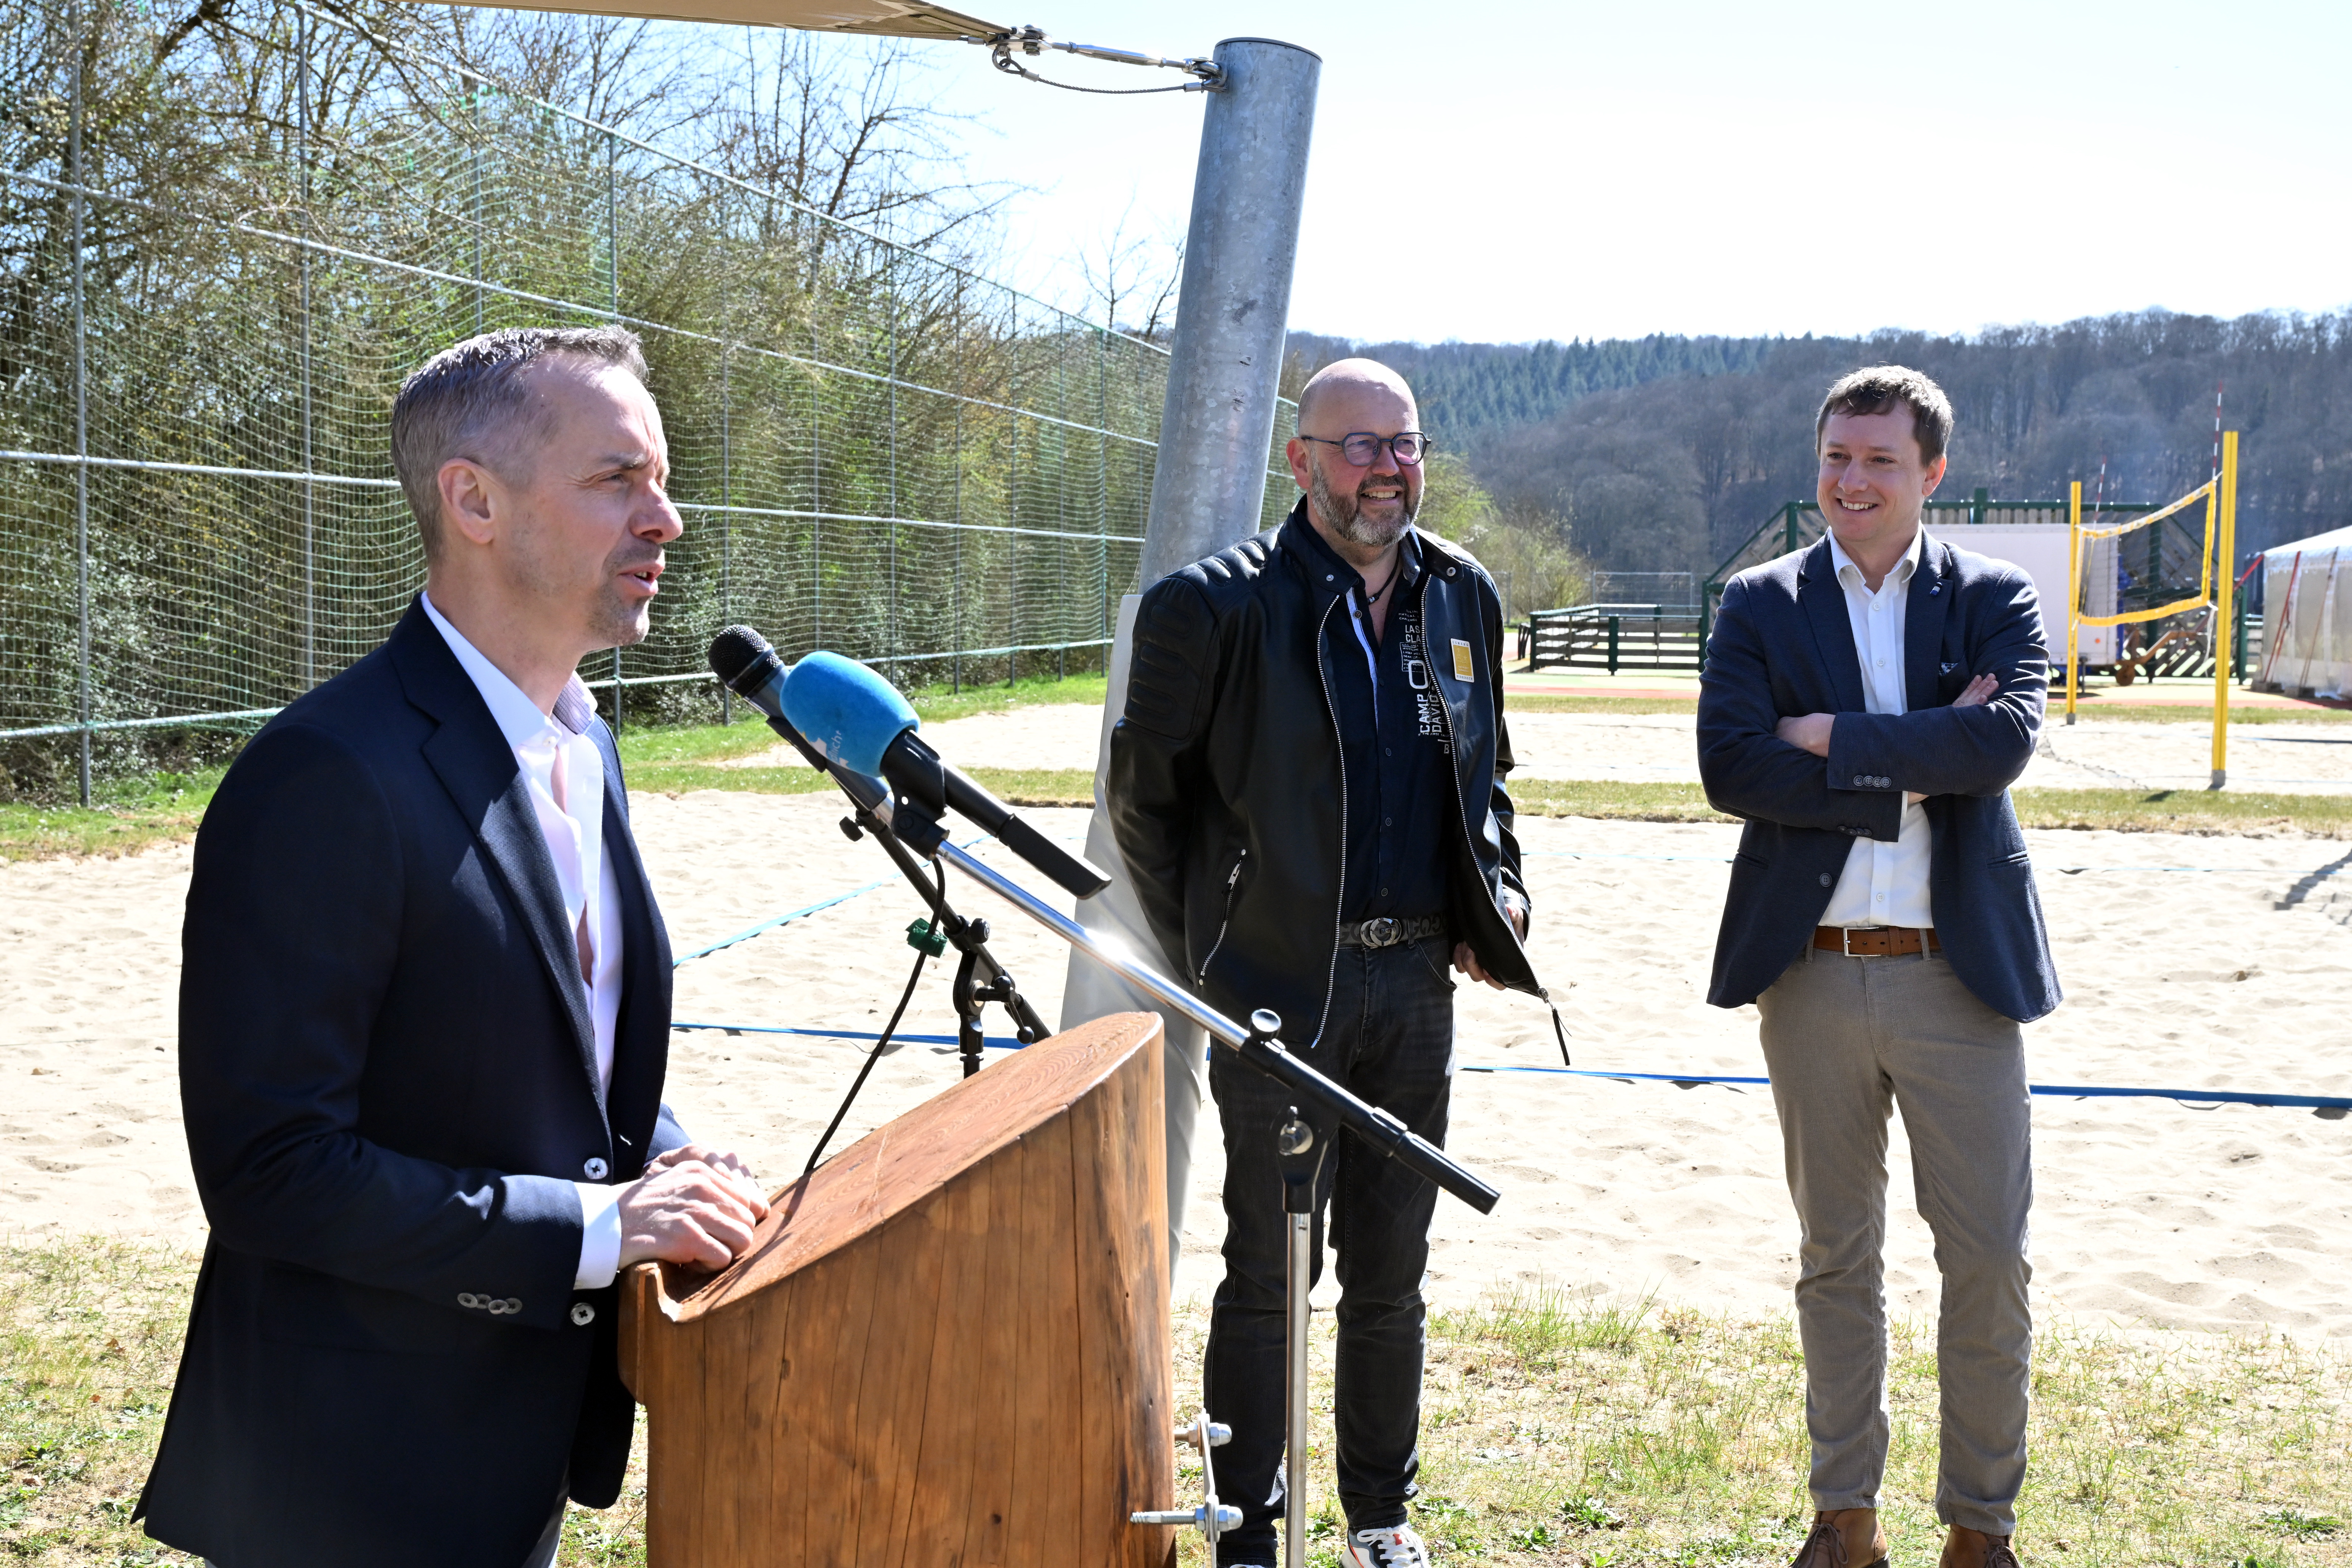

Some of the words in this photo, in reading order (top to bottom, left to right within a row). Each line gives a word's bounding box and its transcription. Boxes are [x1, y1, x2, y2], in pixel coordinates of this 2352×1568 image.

[1405, 625, 1420, 633] LAS
[1405, 634, 1421, 643] CLA
[1417, 694, 1430, 733] CAMP
[1429, 694, 1442, 733] DAVID
